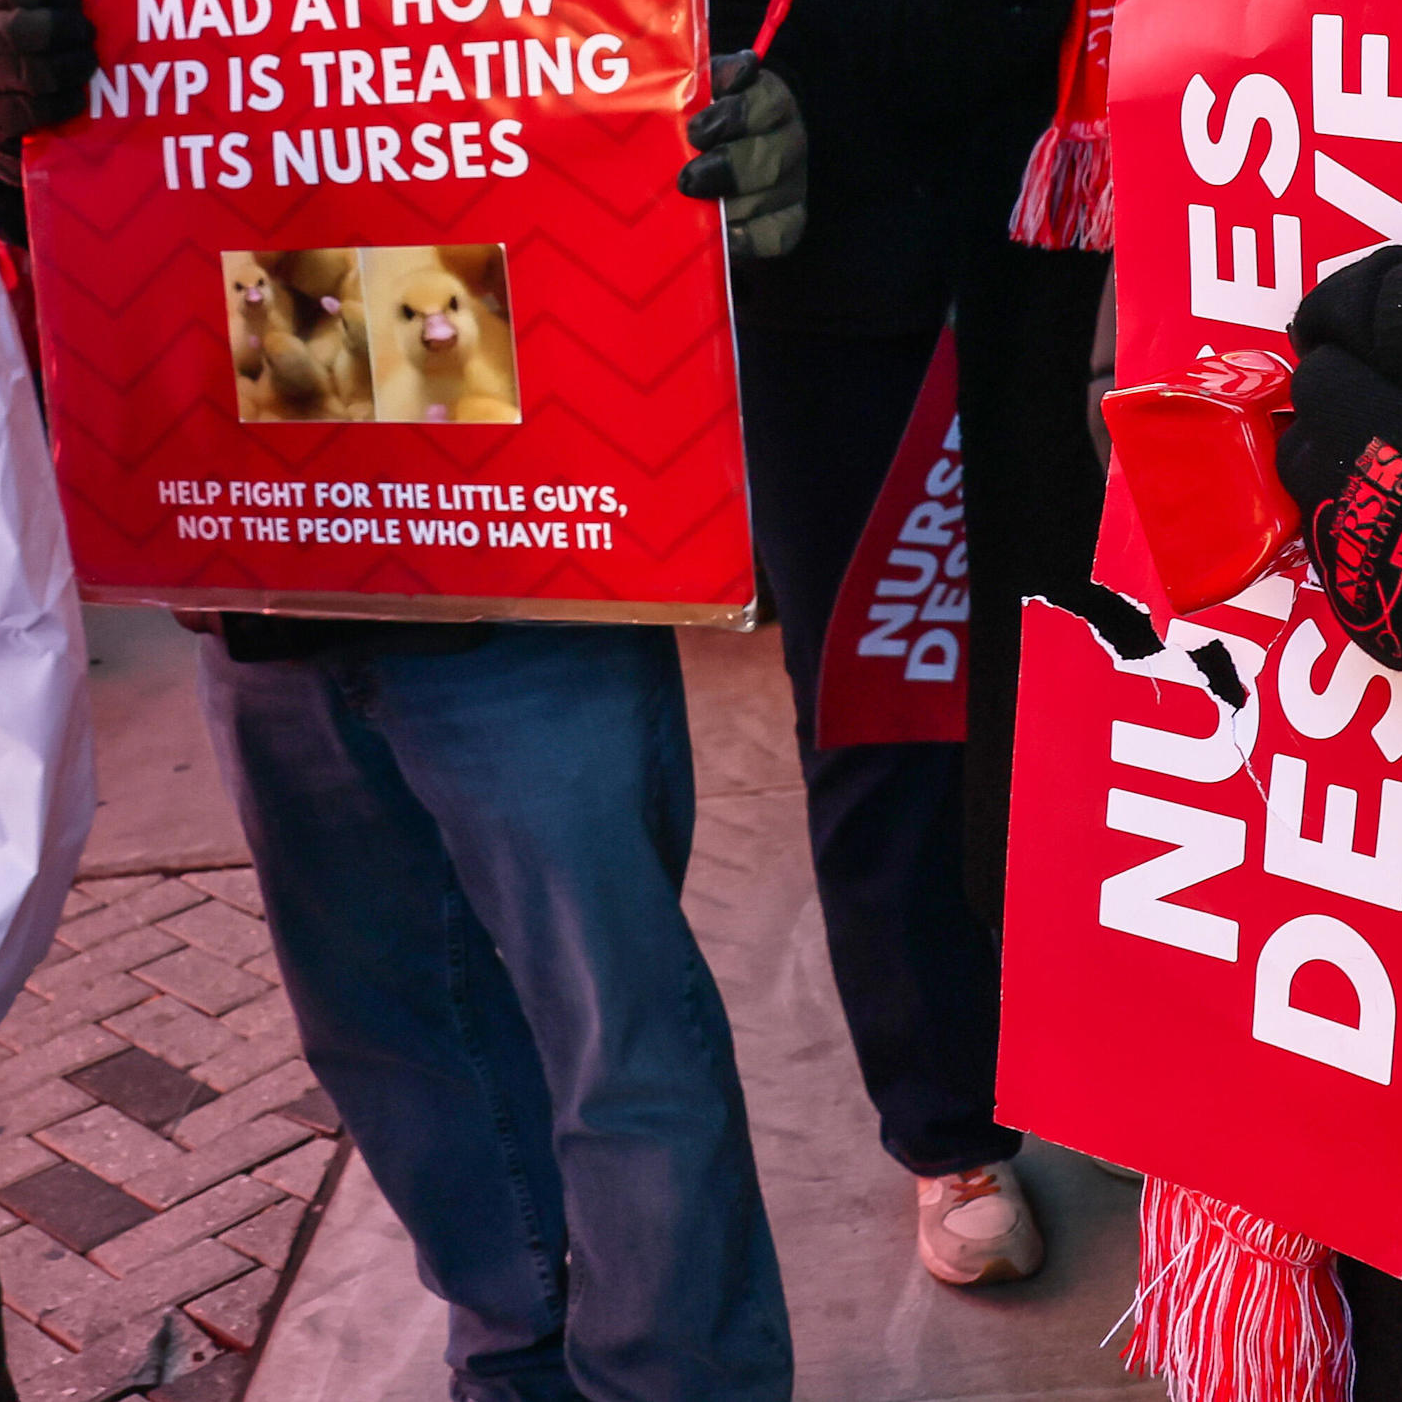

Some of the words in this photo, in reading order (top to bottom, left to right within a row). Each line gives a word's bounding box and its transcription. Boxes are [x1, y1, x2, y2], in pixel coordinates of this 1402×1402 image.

[89, 59, 209, 119] NYP
[228, 54, 285, 113] IS
[299, 33, 631, 109] TREATING
[162, 132, 252, 191] ITS
[272, 118, 530, 187] NURSES
[159, 481, 222, 505] HELP
[229, 482, 306, 508] FIGHT
[314, 482, 373, 509] FOR
[378, 483, 431, 510] THE
[437, 484, 526, 512] LITTLE
[533, 485, 629, 518] GUYS,
[178, 516, 233, 540] NOT
[240, 517, 291, 542] THE
[297, 518, 401, 545] PEOPLE
[407, 519, 481, 547] WHO
[487, 521, 570, 549] HAVE
[576, 522, 614, 550] IT!
[857, 413, 965, 658] NURS
[1099, 72, 1304, 964] NUES
